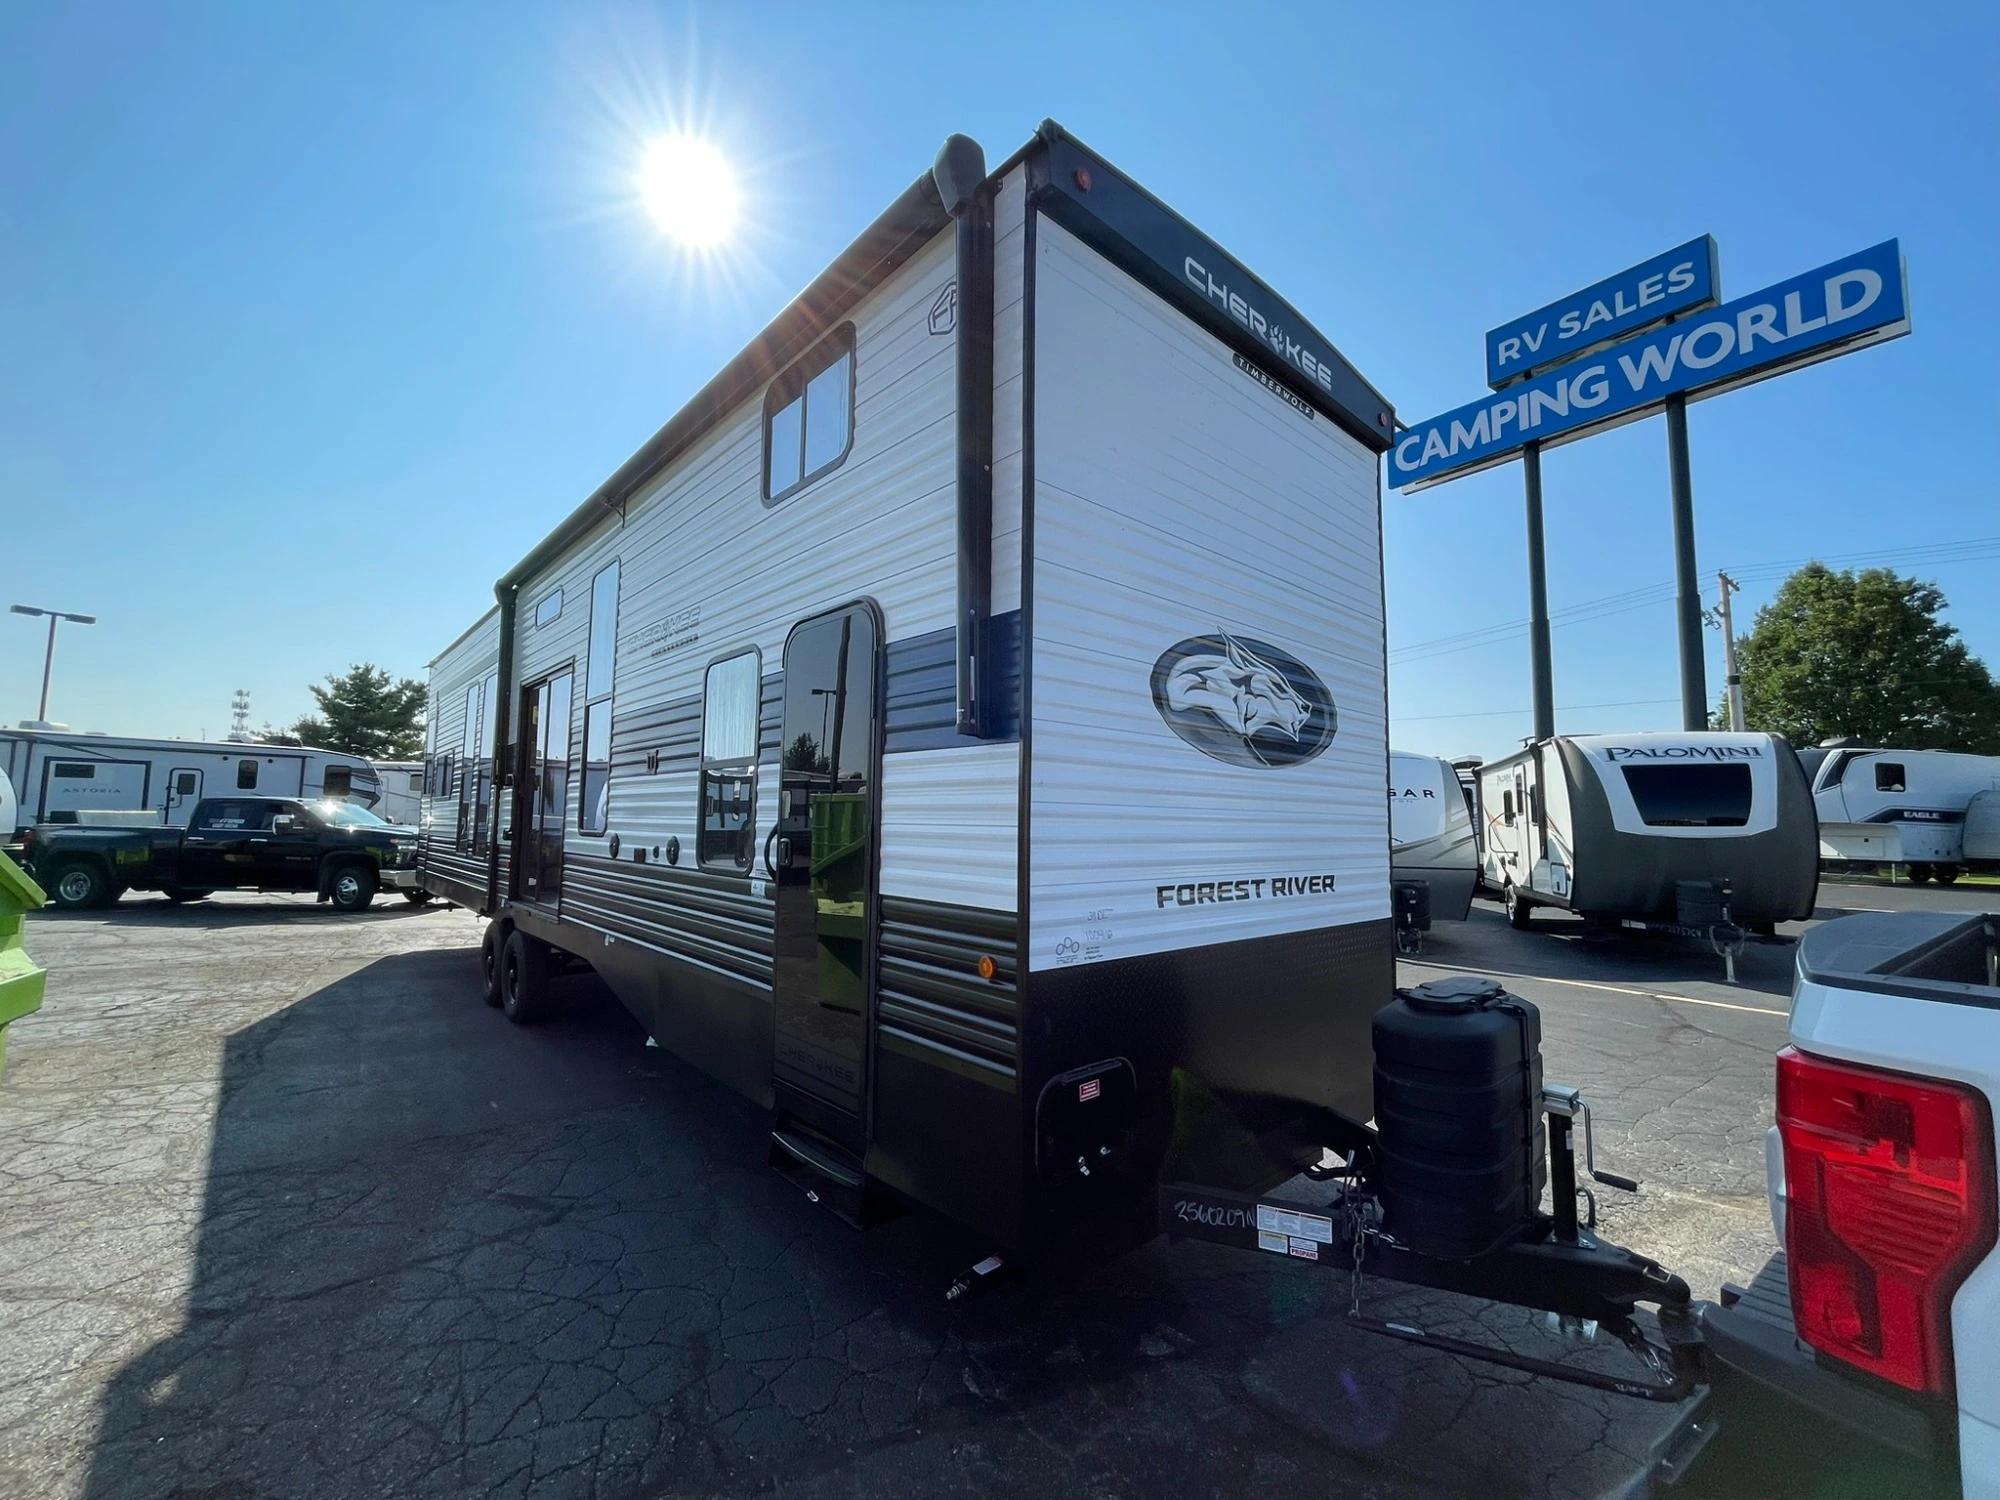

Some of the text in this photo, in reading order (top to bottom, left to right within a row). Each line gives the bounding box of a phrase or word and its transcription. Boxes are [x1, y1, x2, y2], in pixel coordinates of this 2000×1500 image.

[1498, 261, 1696, 366] RV SALES
[1238, 356, 1312, 415] TIMBERWOLF
[1394, 268, 1883, 472] CAMPING WORLD
[1602, 746, 1763, 762] PALOMINI
[1903, 811, 1940, 820] EAGLE
[1156, 874, 1336, 909] FOREST RIVER
[1291, 1248, 1317, 1260] PROPANE
